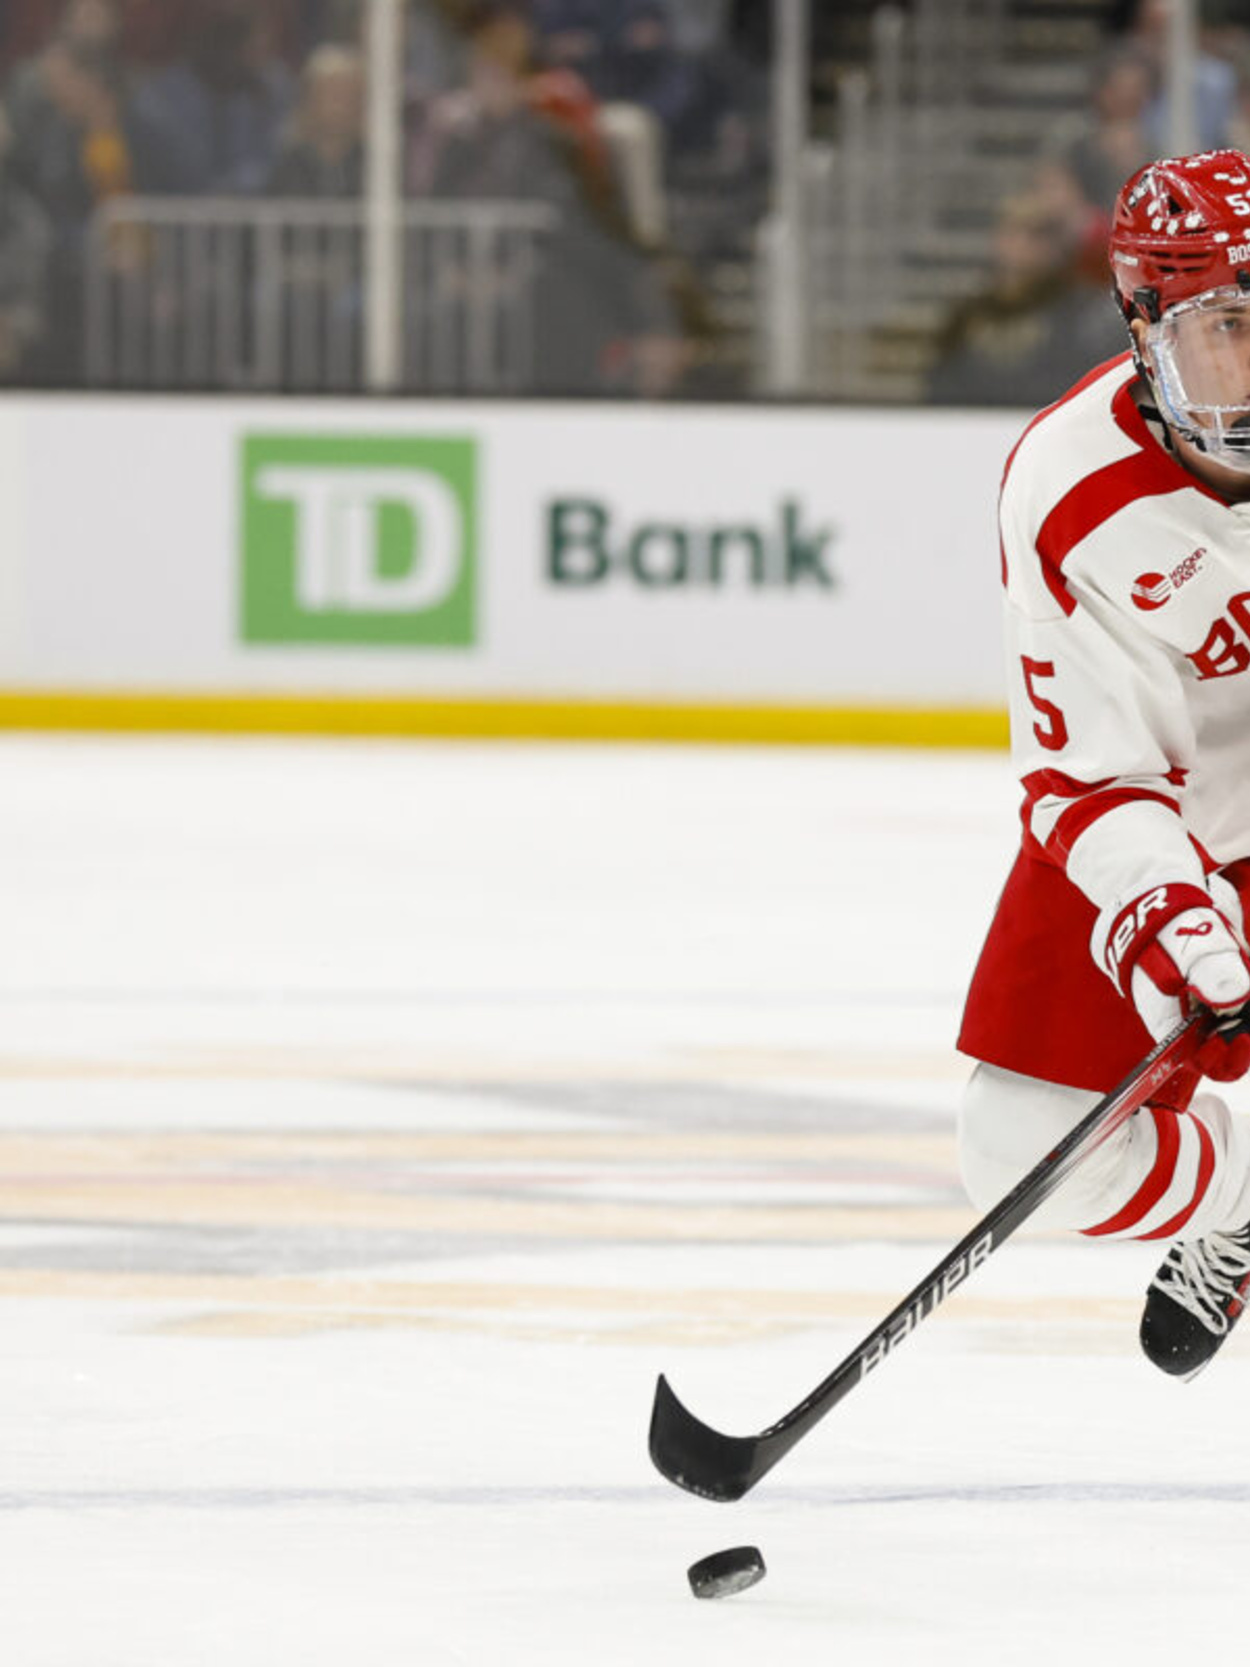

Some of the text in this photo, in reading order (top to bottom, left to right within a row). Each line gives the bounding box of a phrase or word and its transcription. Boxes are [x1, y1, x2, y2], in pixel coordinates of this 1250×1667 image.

[1225, 193, 1250, 215] 5
[254, 463, 838, 612] TD Bank
[1021, 654, 1070, 752] 5
